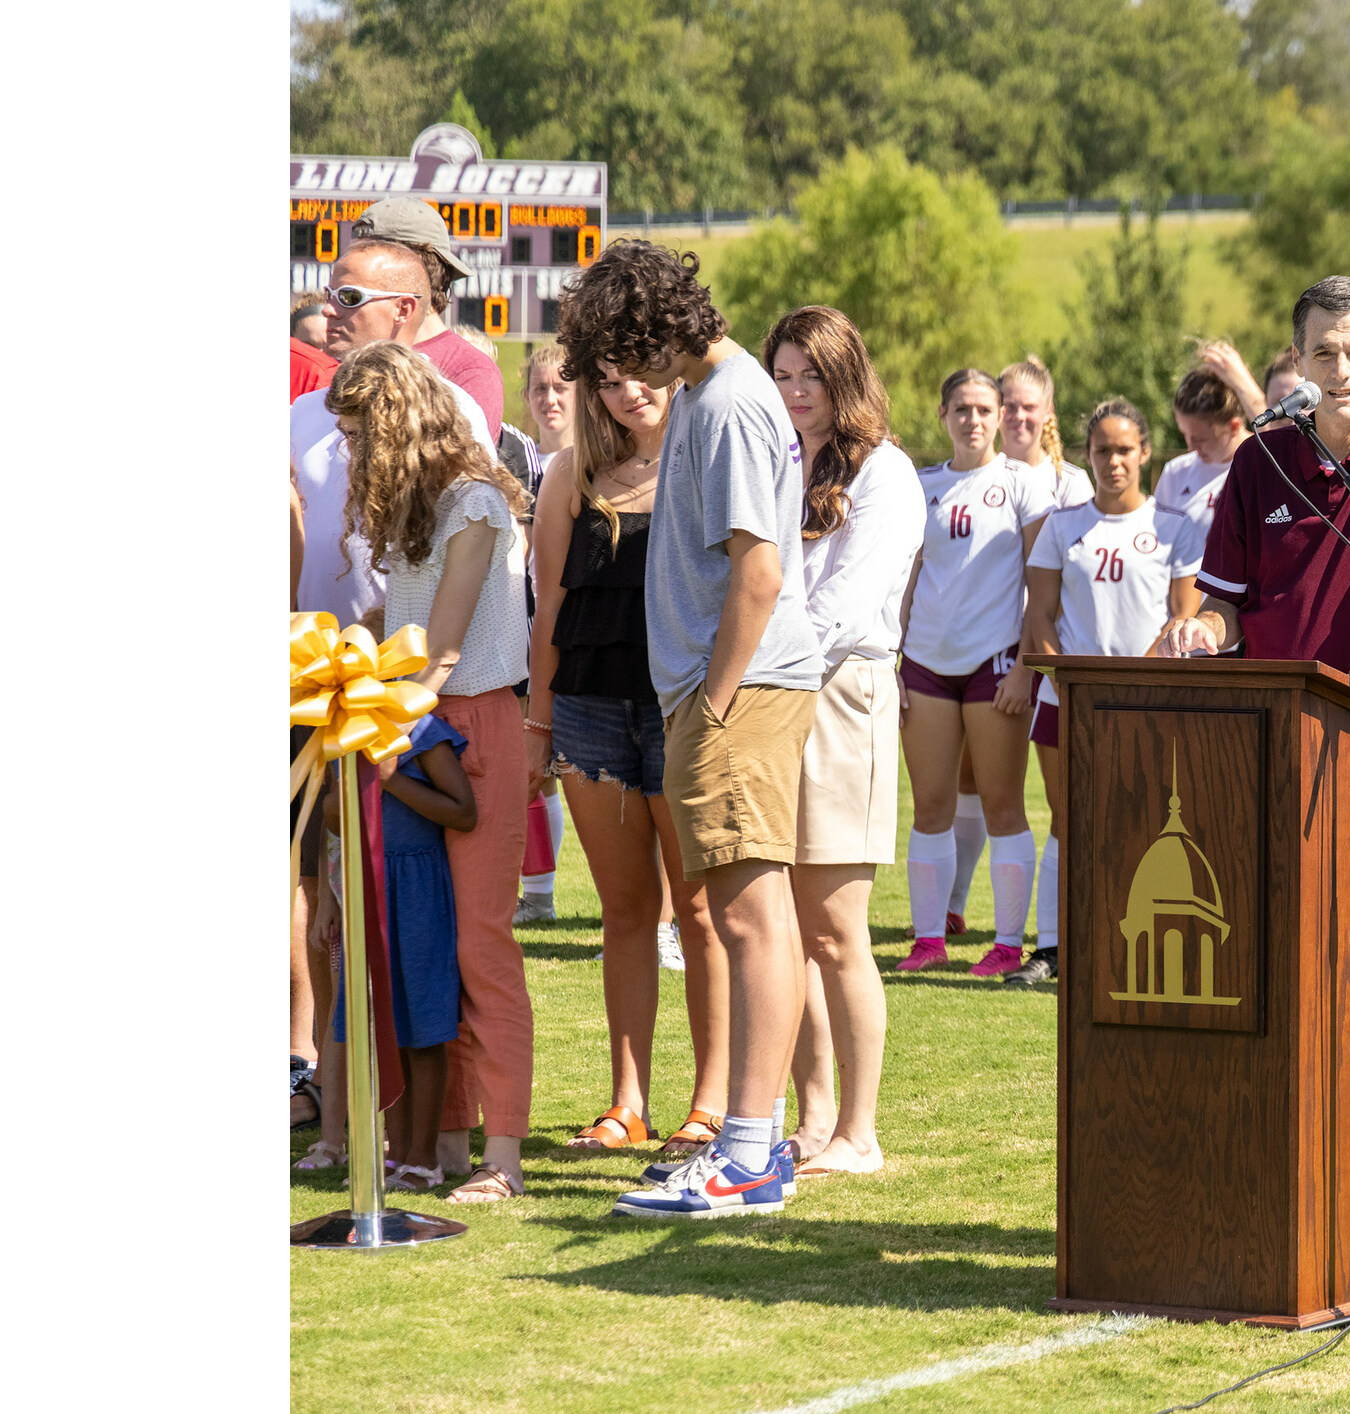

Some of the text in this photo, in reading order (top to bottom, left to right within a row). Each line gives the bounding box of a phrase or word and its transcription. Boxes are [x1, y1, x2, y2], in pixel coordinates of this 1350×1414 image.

[295, 161, 600, 196] LIONS SOCCER
[290, 198, 329, 221] LADY
[510, 204, 588, 228] BULLDOGS
[315, 219, 339, 263] 0
[577, 225, 601, 267] 0
[485, 293, 508, 337] 0
[950, 504, 971, 539] 16
[1265, 515, 1292, 524] adidas
[1094, 547, 1123, 583] 26
